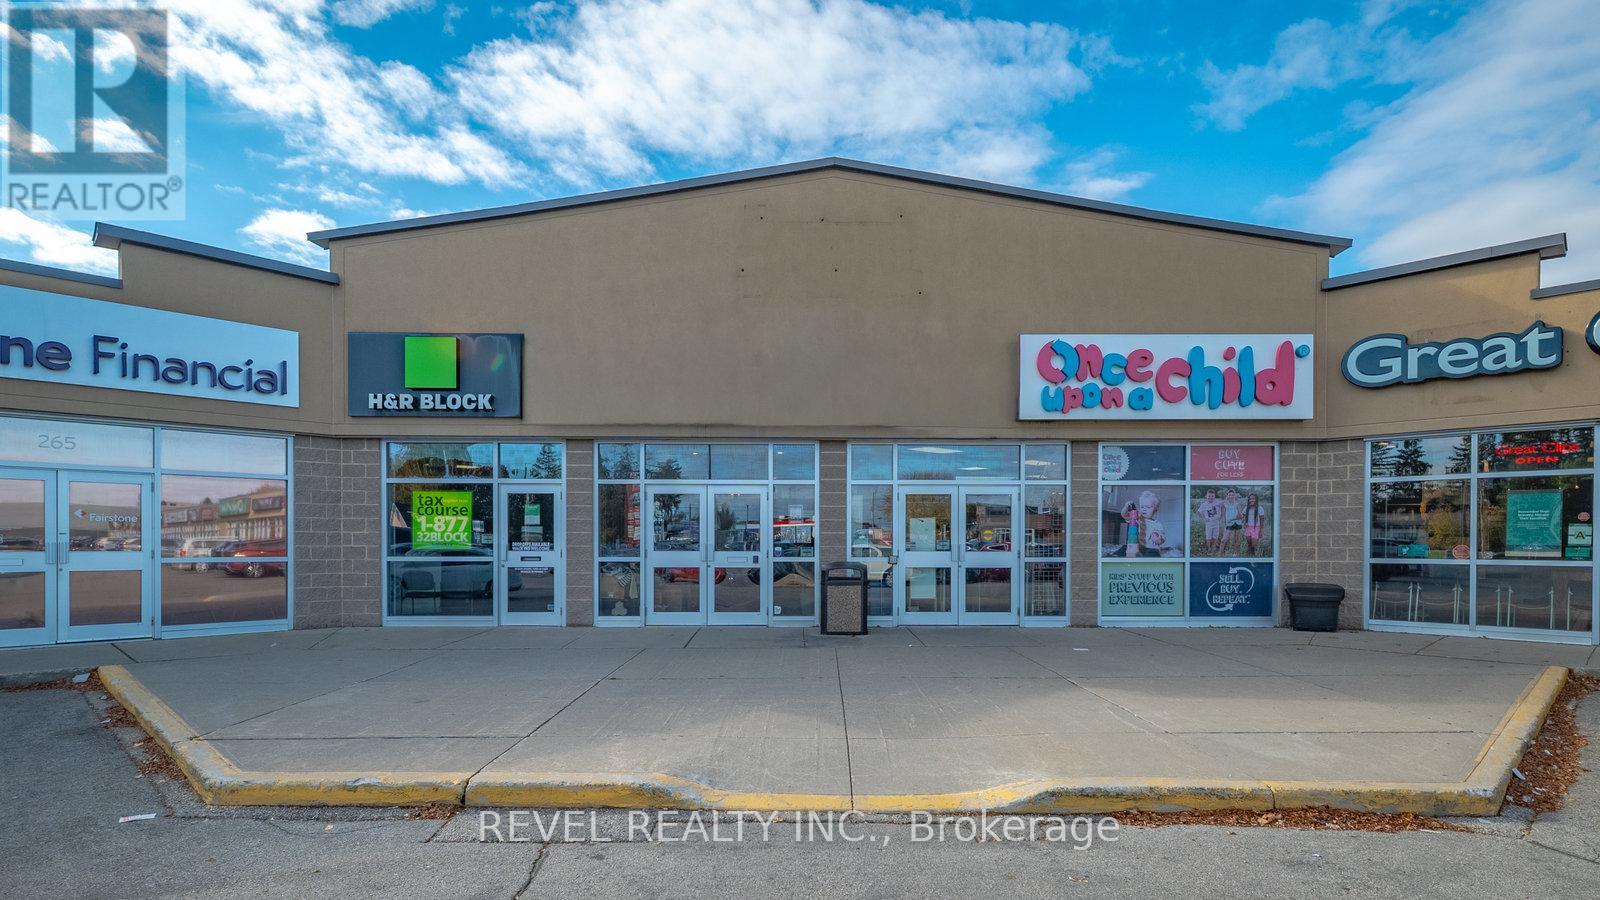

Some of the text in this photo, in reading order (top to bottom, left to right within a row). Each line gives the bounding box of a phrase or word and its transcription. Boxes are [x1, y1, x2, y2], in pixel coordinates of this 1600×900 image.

[1346, 327, 1557, 384] Great
[92, 334, 288, 396] Financial
[368, 393, 494, 410] H&R BLOCK
[1041, 383, 1154, 414] upon a
[38, 434, 77, 450] 265
[1514, 456, 1558, 465] OPEN
[417, 494, 444, 506] tax
[417, 506, 468, 516] course
[89, 512, 138, 523] Fairstone
[416, 515, 469, 532] 1-877
[417, 532, 468, 542] 32BLOCK
[1575, 531, 1585, 540] A
[1109, 581, 1174, 593] PREVIOUS
[1109, 594, 1175, 605] EXPERIENCE
